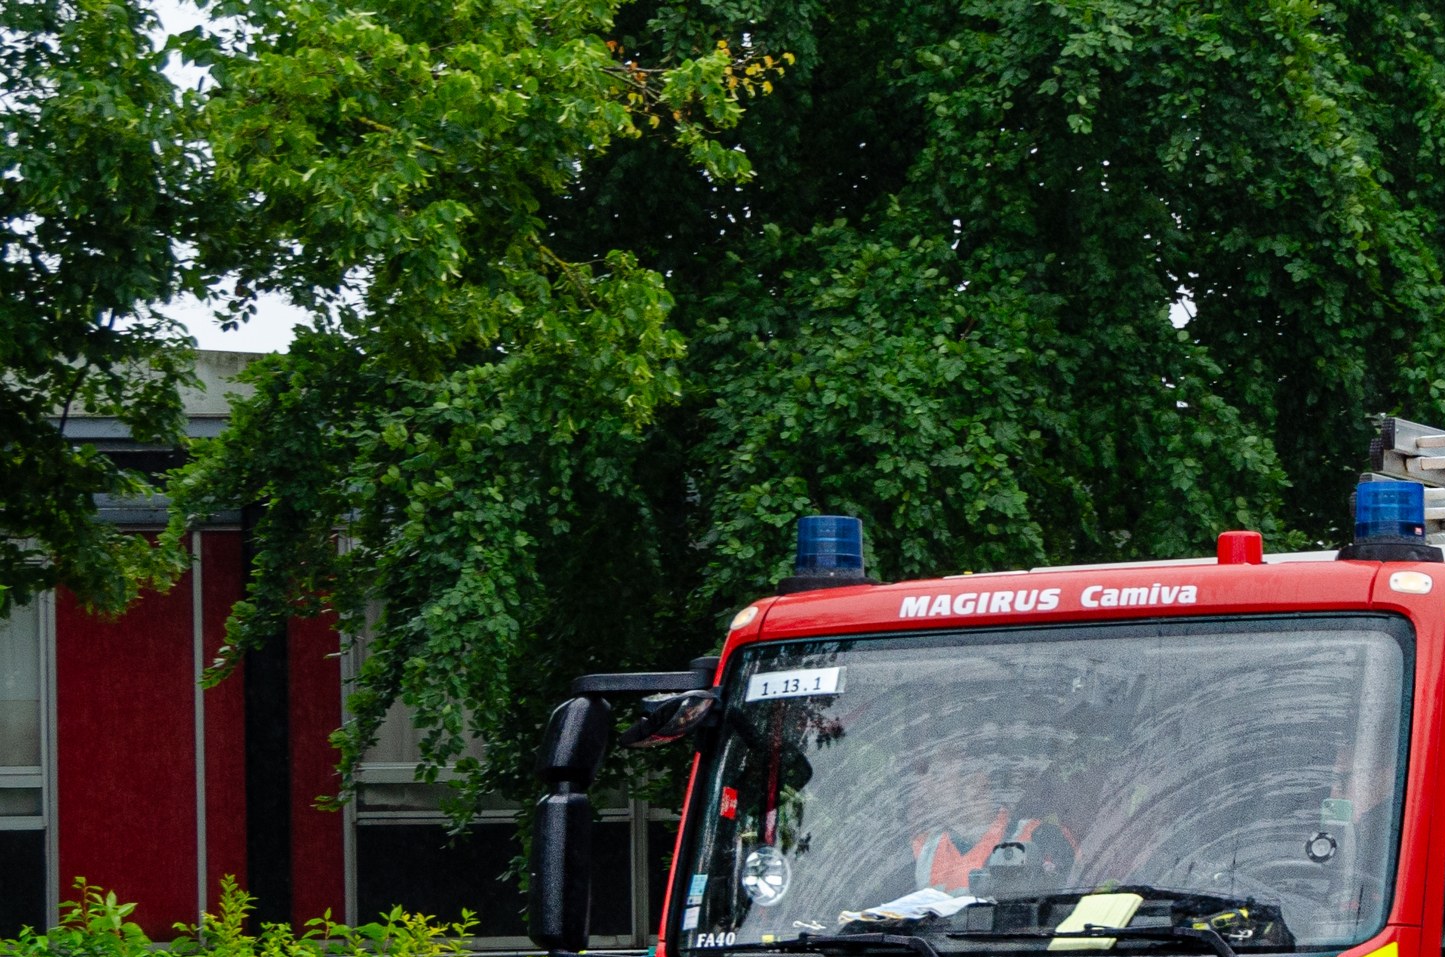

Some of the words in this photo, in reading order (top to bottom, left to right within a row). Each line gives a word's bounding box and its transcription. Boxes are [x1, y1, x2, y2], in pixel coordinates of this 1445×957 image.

[899, 588, 1061, 618] MAGIRUS
[1081, 583, 1198, 608] Camiva
[761, 676, 821, 696] 1.13.1
[696, 931, 736, 948] FA40
